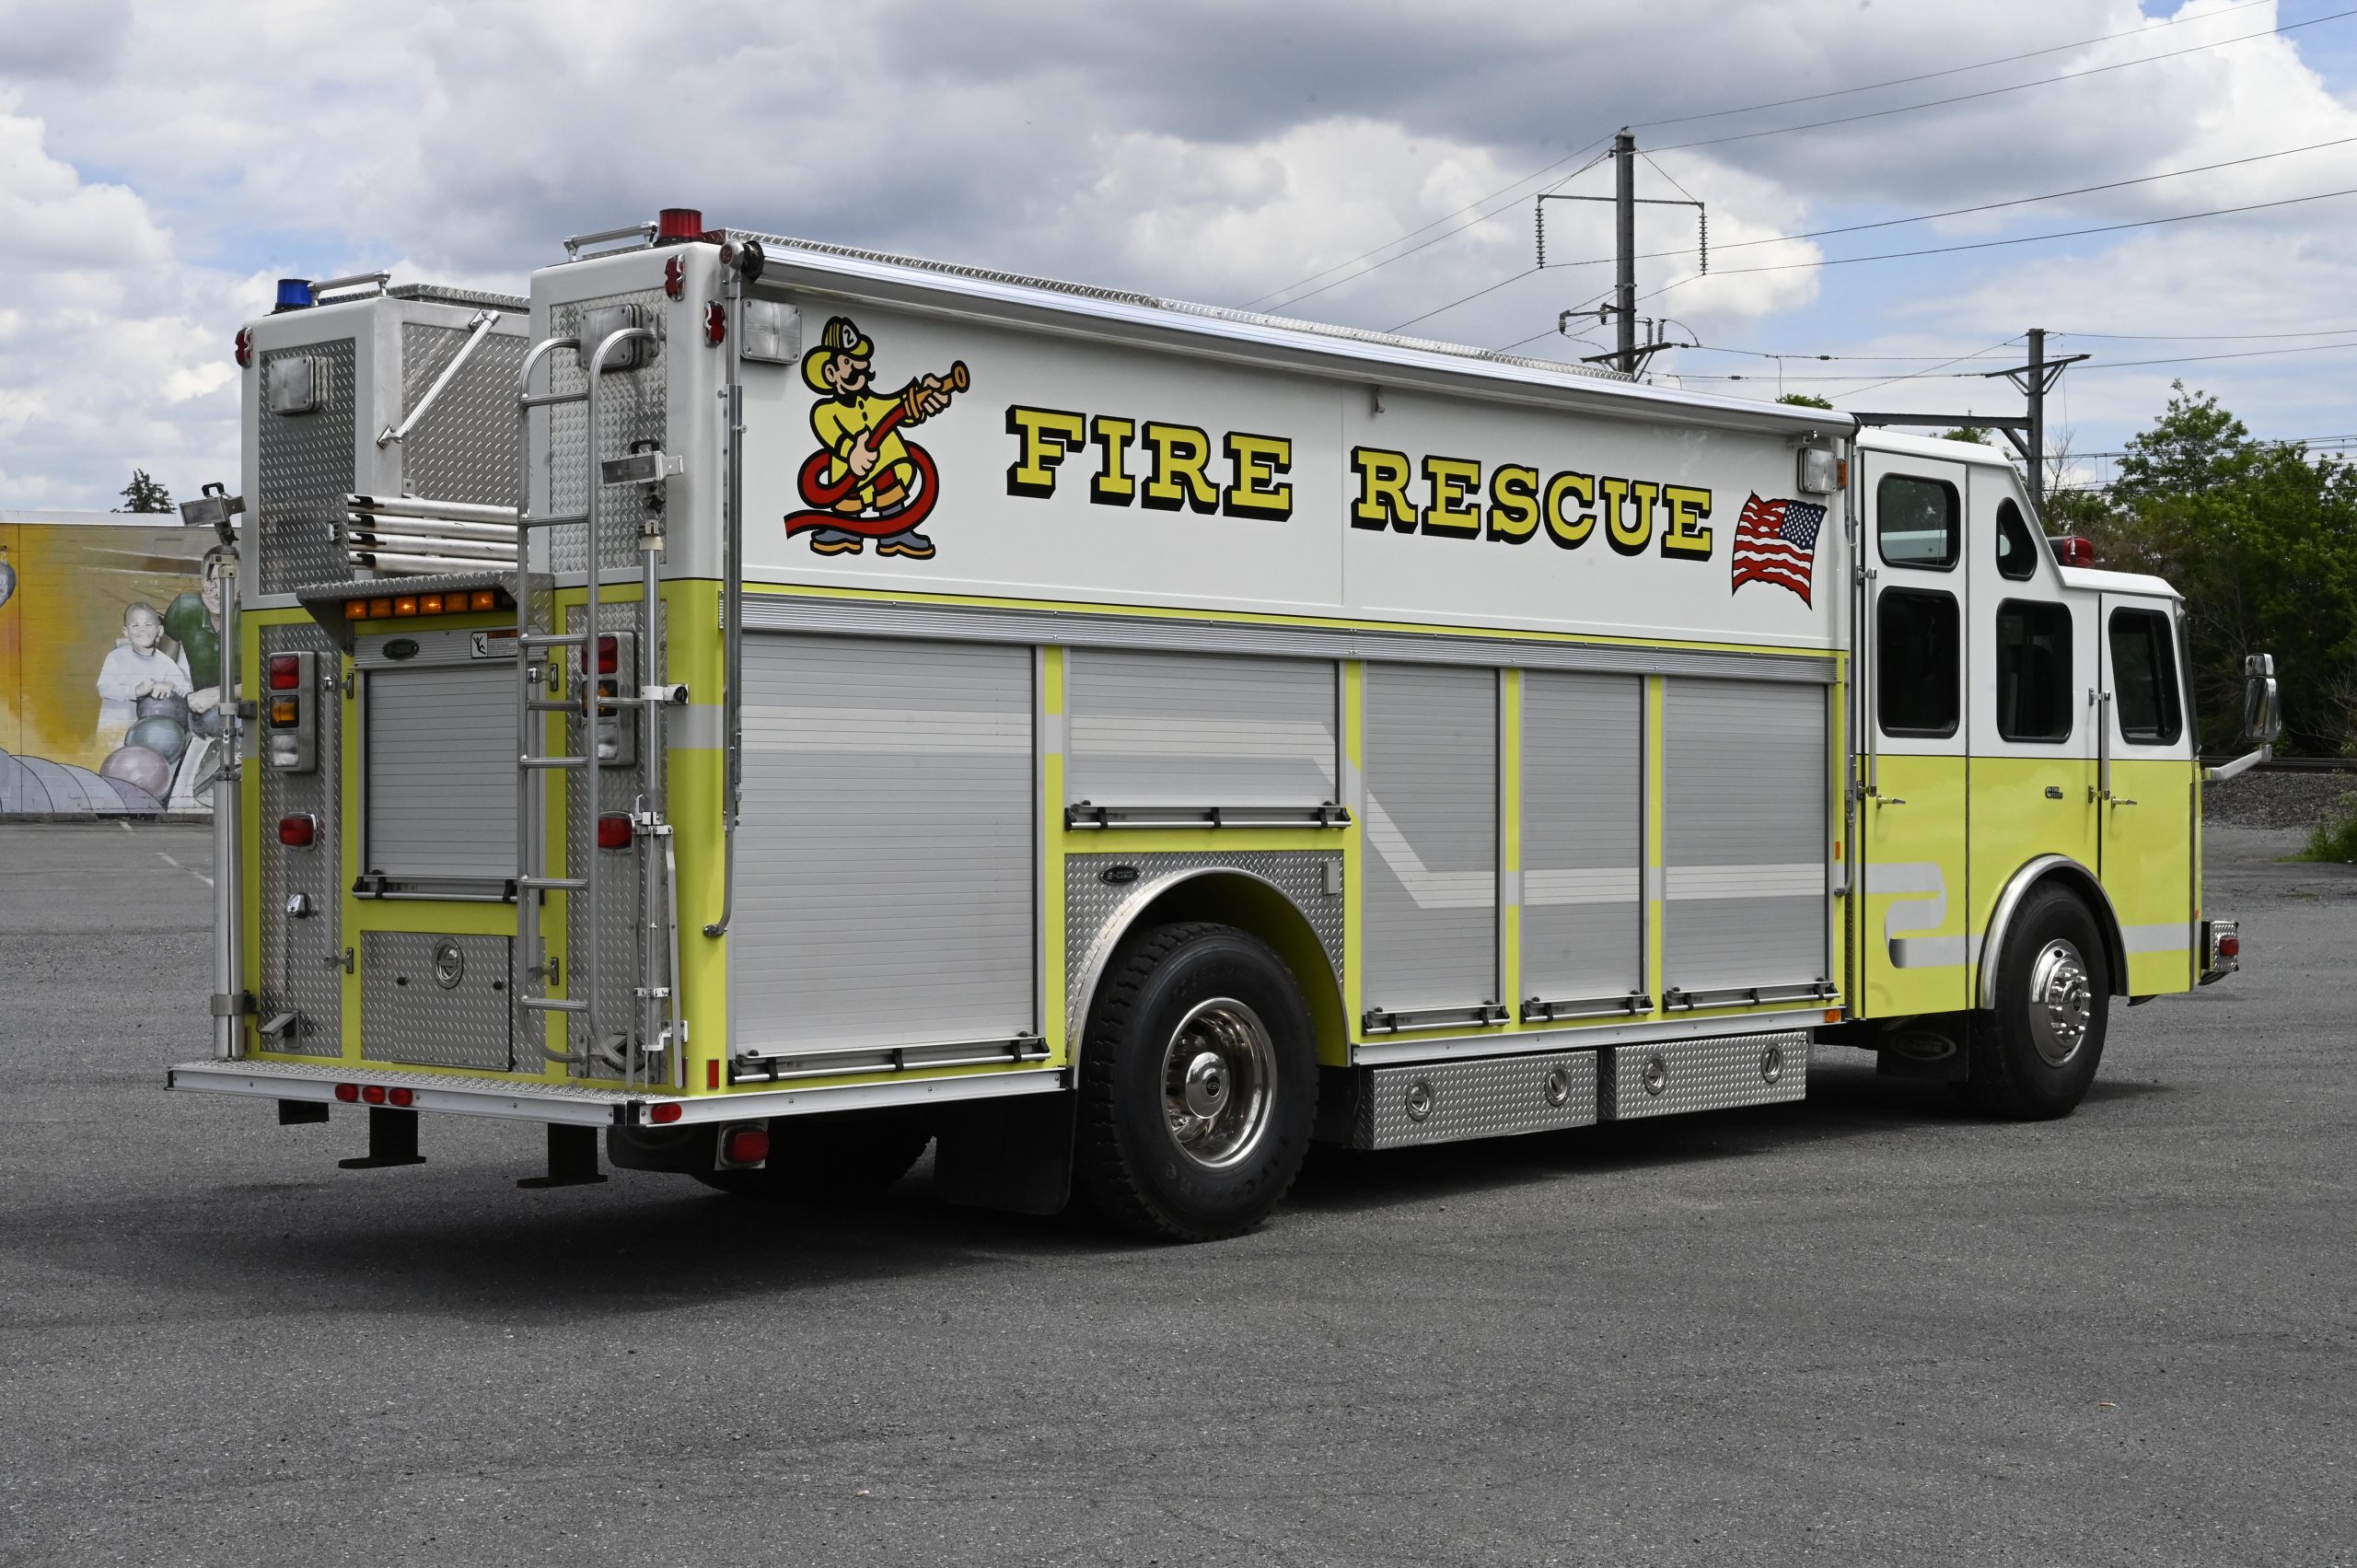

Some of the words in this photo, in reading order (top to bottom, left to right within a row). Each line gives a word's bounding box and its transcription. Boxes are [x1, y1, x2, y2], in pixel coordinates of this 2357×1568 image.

[843, 328, 854, 346] 2
[1005, 403, 1294, 523] FIRE
[1350, 445, 1713, 563] RESCUE
